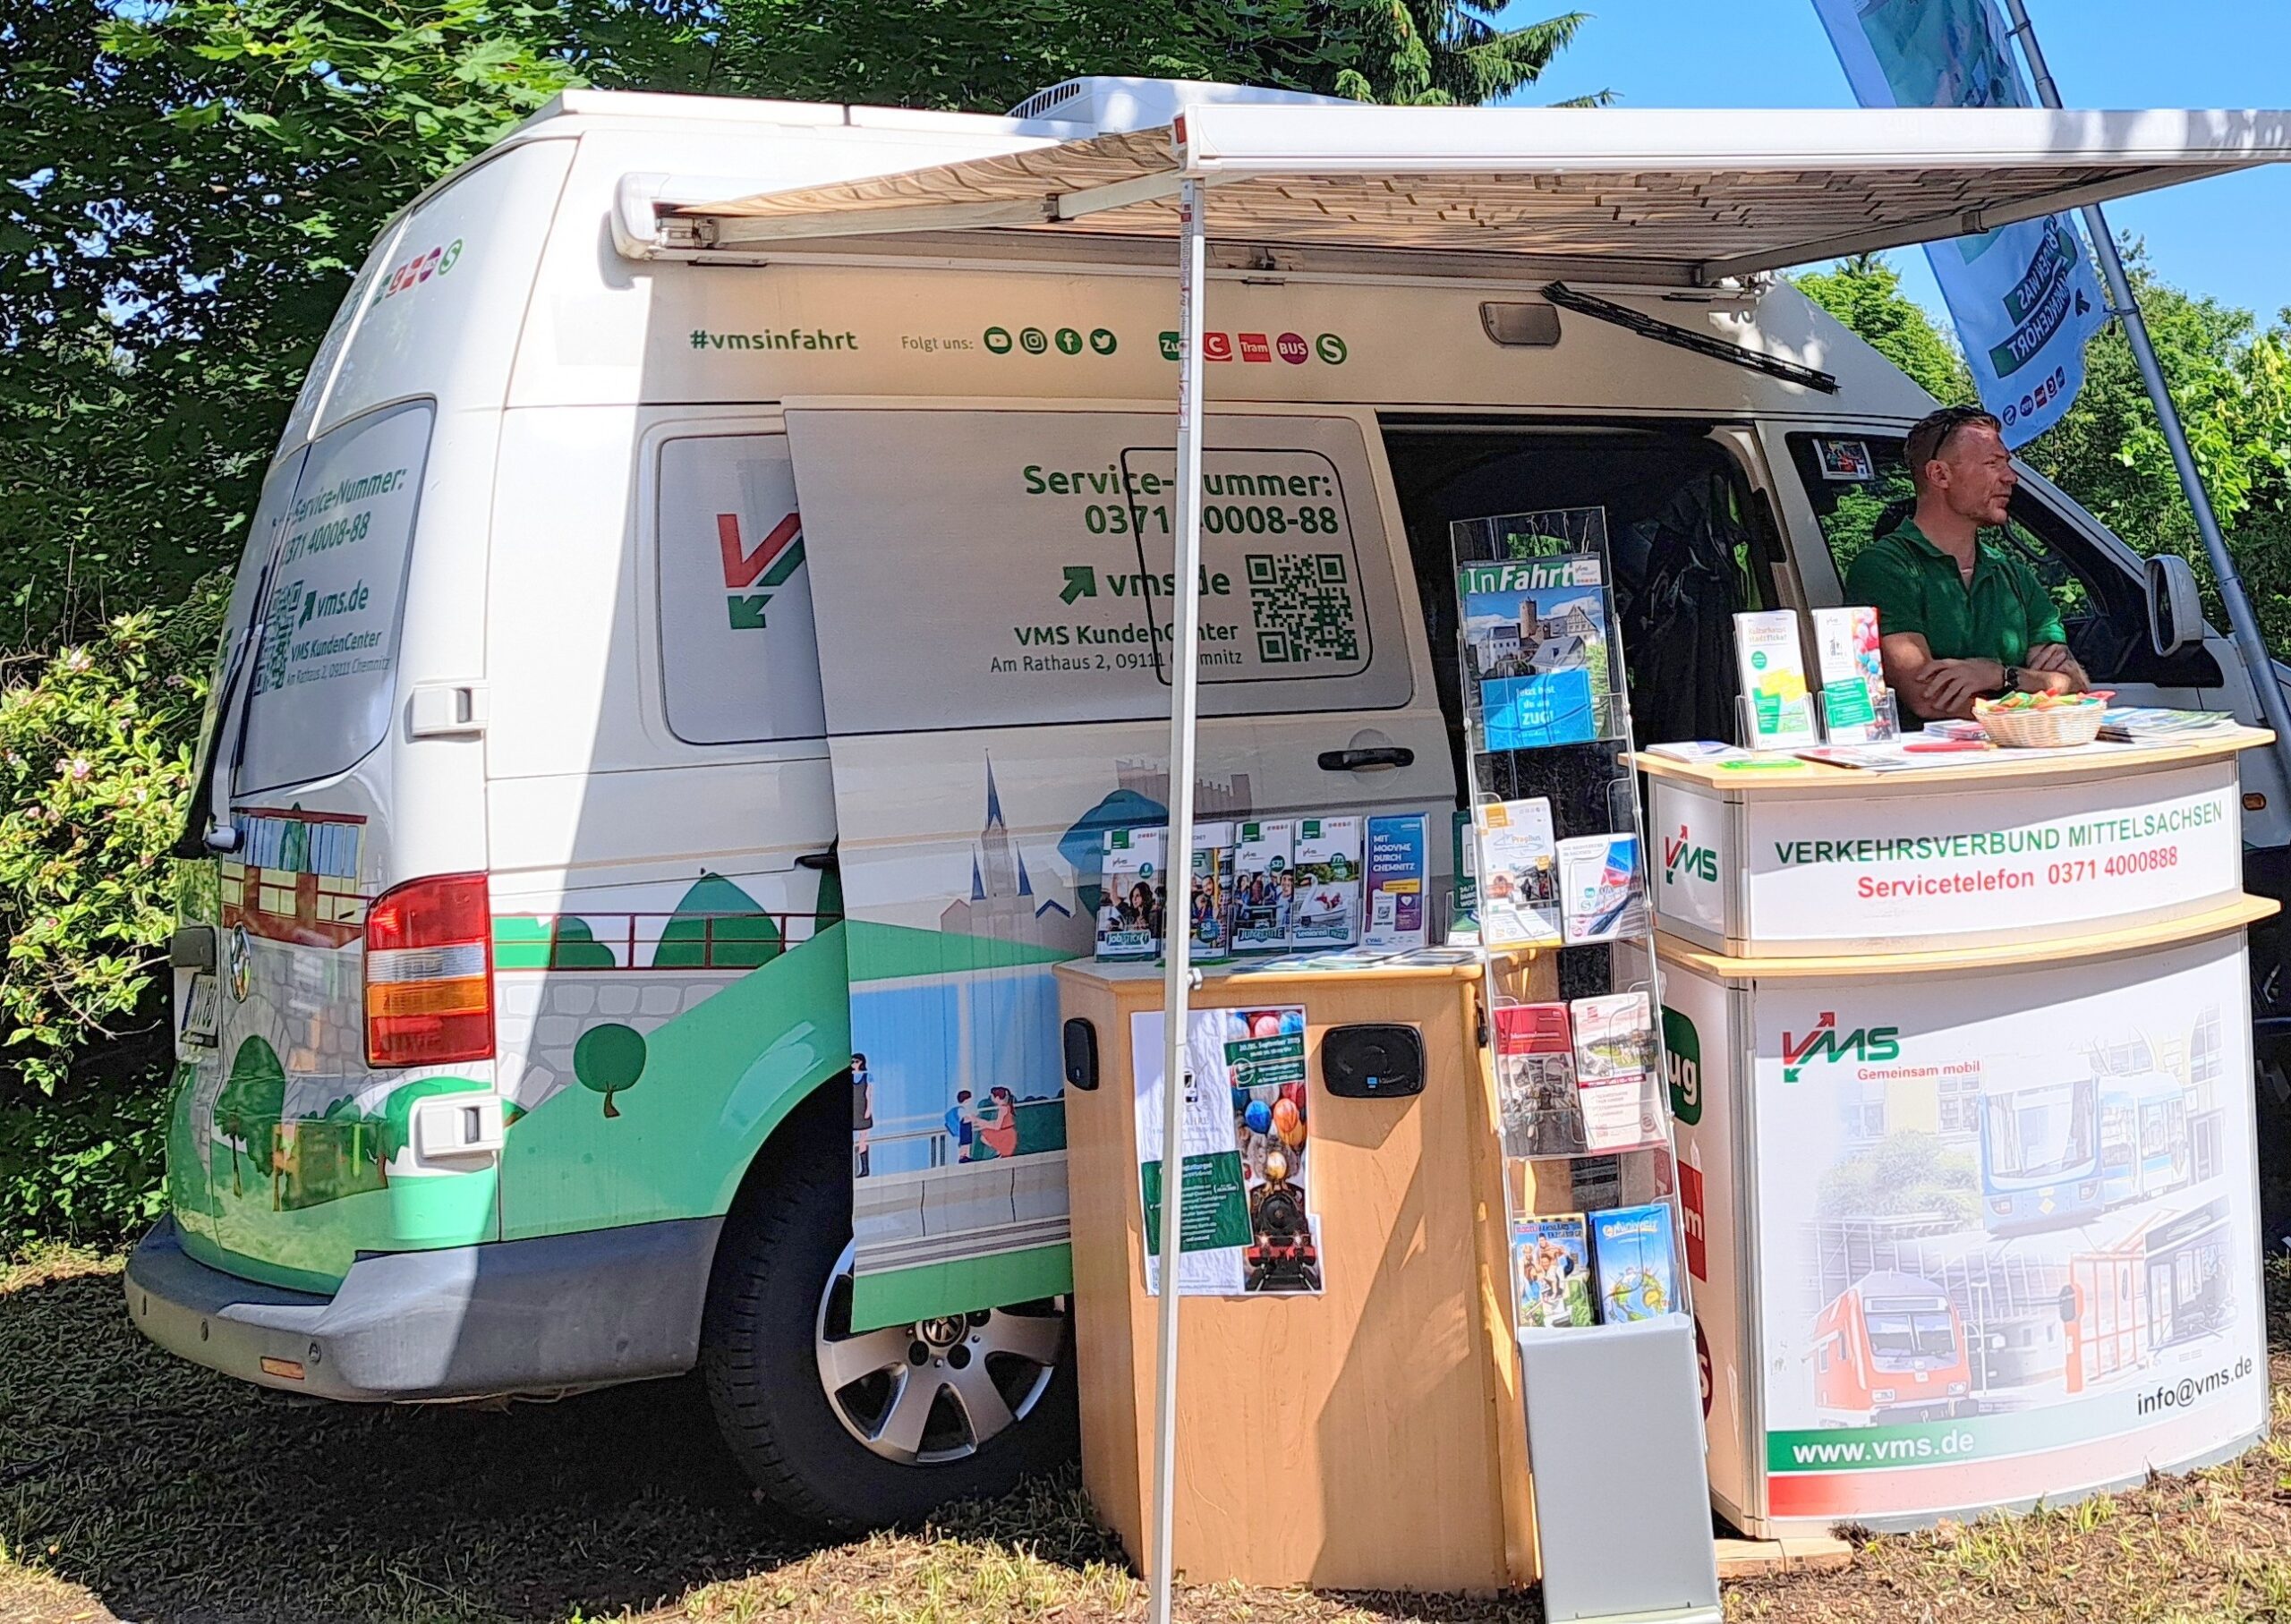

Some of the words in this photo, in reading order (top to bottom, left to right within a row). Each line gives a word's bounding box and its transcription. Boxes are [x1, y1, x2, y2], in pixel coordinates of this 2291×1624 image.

[690, 329, 858, 351] #vmsinfahrt
[901, 336, 939, 353] Folgt
[943, 338, 974, 350] uns:
[1162, 339, 1180, 353] Zu
[1240, 342, 1269, 354] Tram
[1279, 344, 1307, 356] BUS
[1322, 336, 1343, 363] S
[1023, 464, 1333, 497] Service-ummer:
[307, 511, 370, 555] 40008-88
[1085, 505, 1170, 534] 0371
[1199, 505, 1339, 534] 0008-88
[1106, 565, 1231, 597] vmsde
[317, 580, 369, 618] vms.de
[1014, 625, 1070, 647] VMS
[1077, 623, 1239, 646] KundenCnter
[292, 641, 311, 663] VMS
[990, 656, 1018, 673] Am
[1023, 653, 1090, 671] Rathaus
[1094, 654, 1111, 672] 2,
[1115, 652, 1166, 668] 09111
[1171, 649, 1243, 667] mnitz
[1775, 828, 2060, 865] VERKEHRSVERBUND
[2068, 800, 2224, 848] MITTELSACHSEN
[1373, 863, 1416, 872] CHEMNITZ
[1374, 853, 1401, 863] DURCH
[1665, 832, 1718, 883] VMS
[1857, 869, 2035, 898] Servicetelefon
[2048, 859, 2096, 885] 0371
[2104, 846, 2178, 878] 4000888
[1783, 1023, 1900, 1071] VMS
[1667, 1049, 1698, 1105] ug
[1858, 1067, 1938, 1081] Gemeinsam
[1943, 1060, 1980, 1074] mobil
[2137, 1356, 2253, 1416] info@vms.de
[1793, 1430, 1974, 1464] www.vms.de
